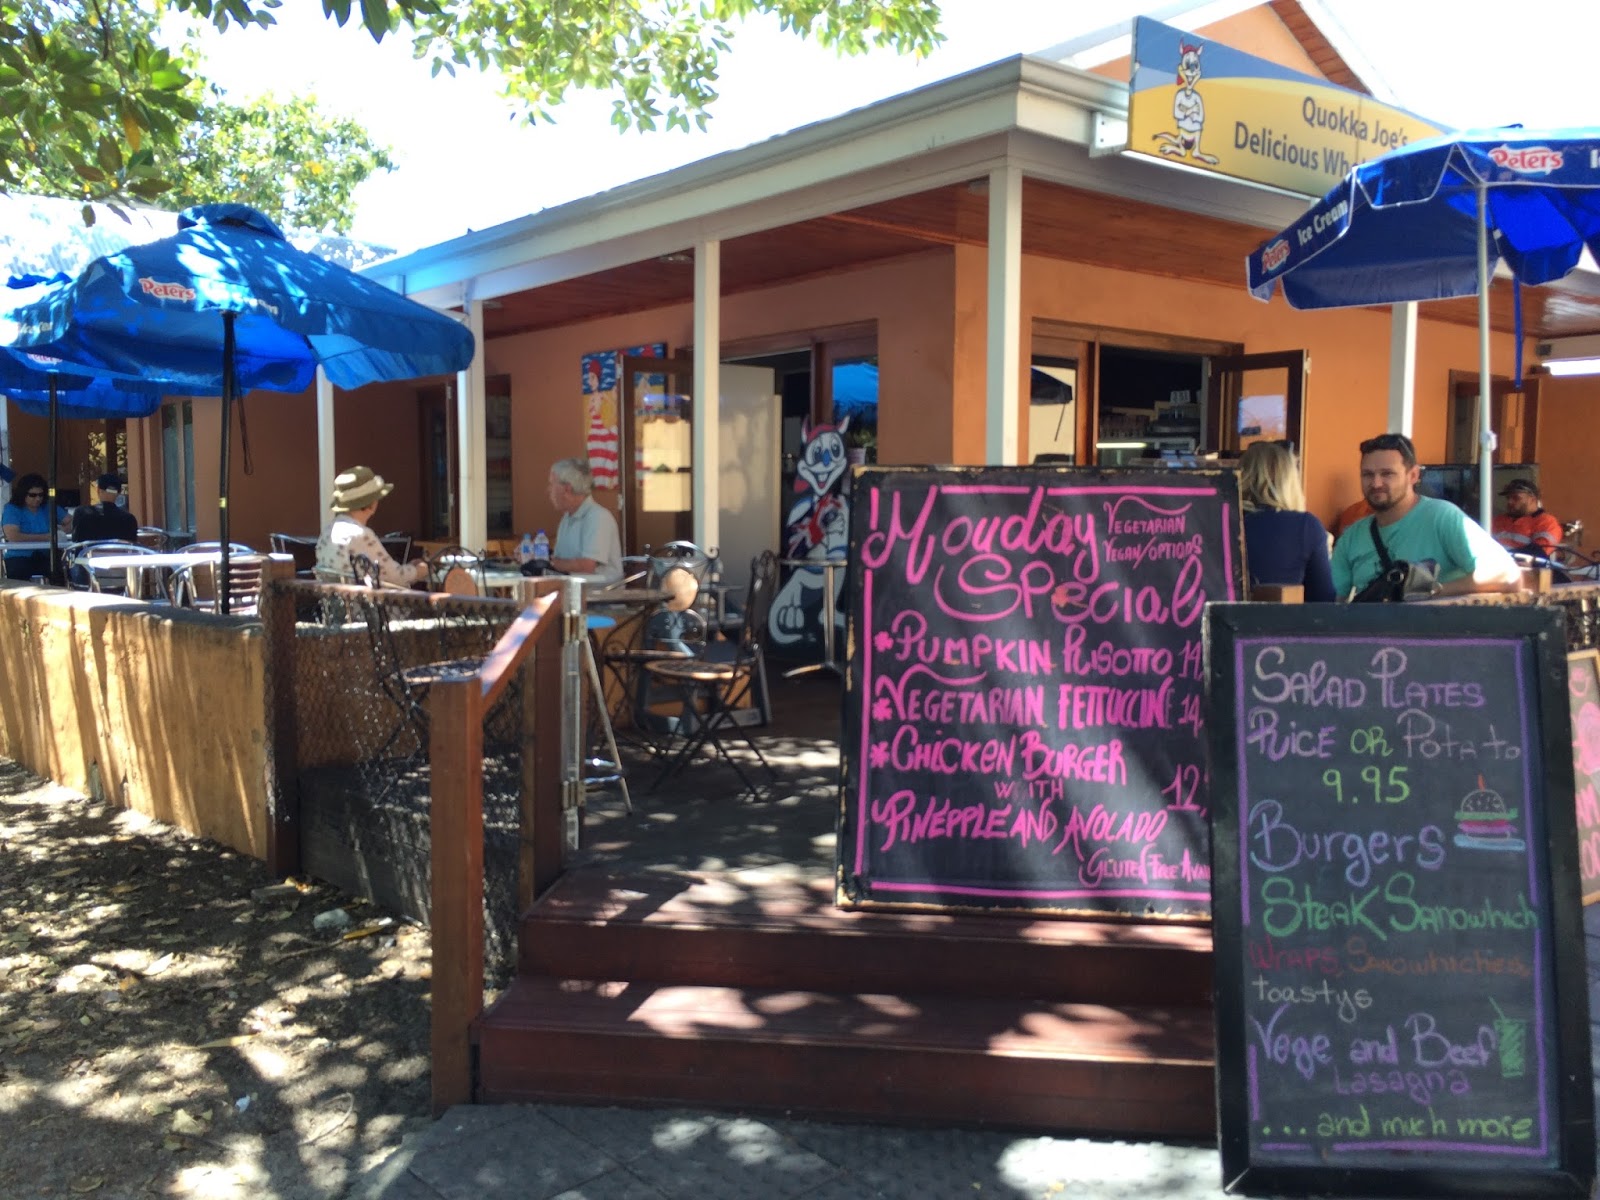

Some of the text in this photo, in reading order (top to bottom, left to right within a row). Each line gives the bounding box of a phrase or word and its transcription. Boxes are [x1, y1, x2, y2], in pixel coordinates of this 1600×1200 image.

[1234, 121, 1319, 170] Delicious
[1302, 96, 1408, 150] Quokka Joe's
[1489, 147, 1563, 171] Peters
[1297, 225, 1313, 247] Ice
[1313, 200, 1348, 234] Cream
[139, 278, 196, 301] Peters
[891, 609, 1051, 675] PUMPKIN
[1064, 624, 1173, 676] RISOTTO
[875, 663, 1045, 726] VEGETARIAN
[1020, 730, 1127, 787] BURGER
[1322, 766, 1410, 804] 9.95
[1010, 797, 1058, 848] AND
[1249, 800, 1444, 887] Burgers
[1247, 1004, 1334, 1080] Vege
[1350, 1024, 1399, 1064] and
[1333, 1065, 1471, 1106] Lasagna
[1317, 1103, 1370, 1137] and
[1381, 1104, 1447, 1137] much
[1458, 1116, 1533, 1140] more
